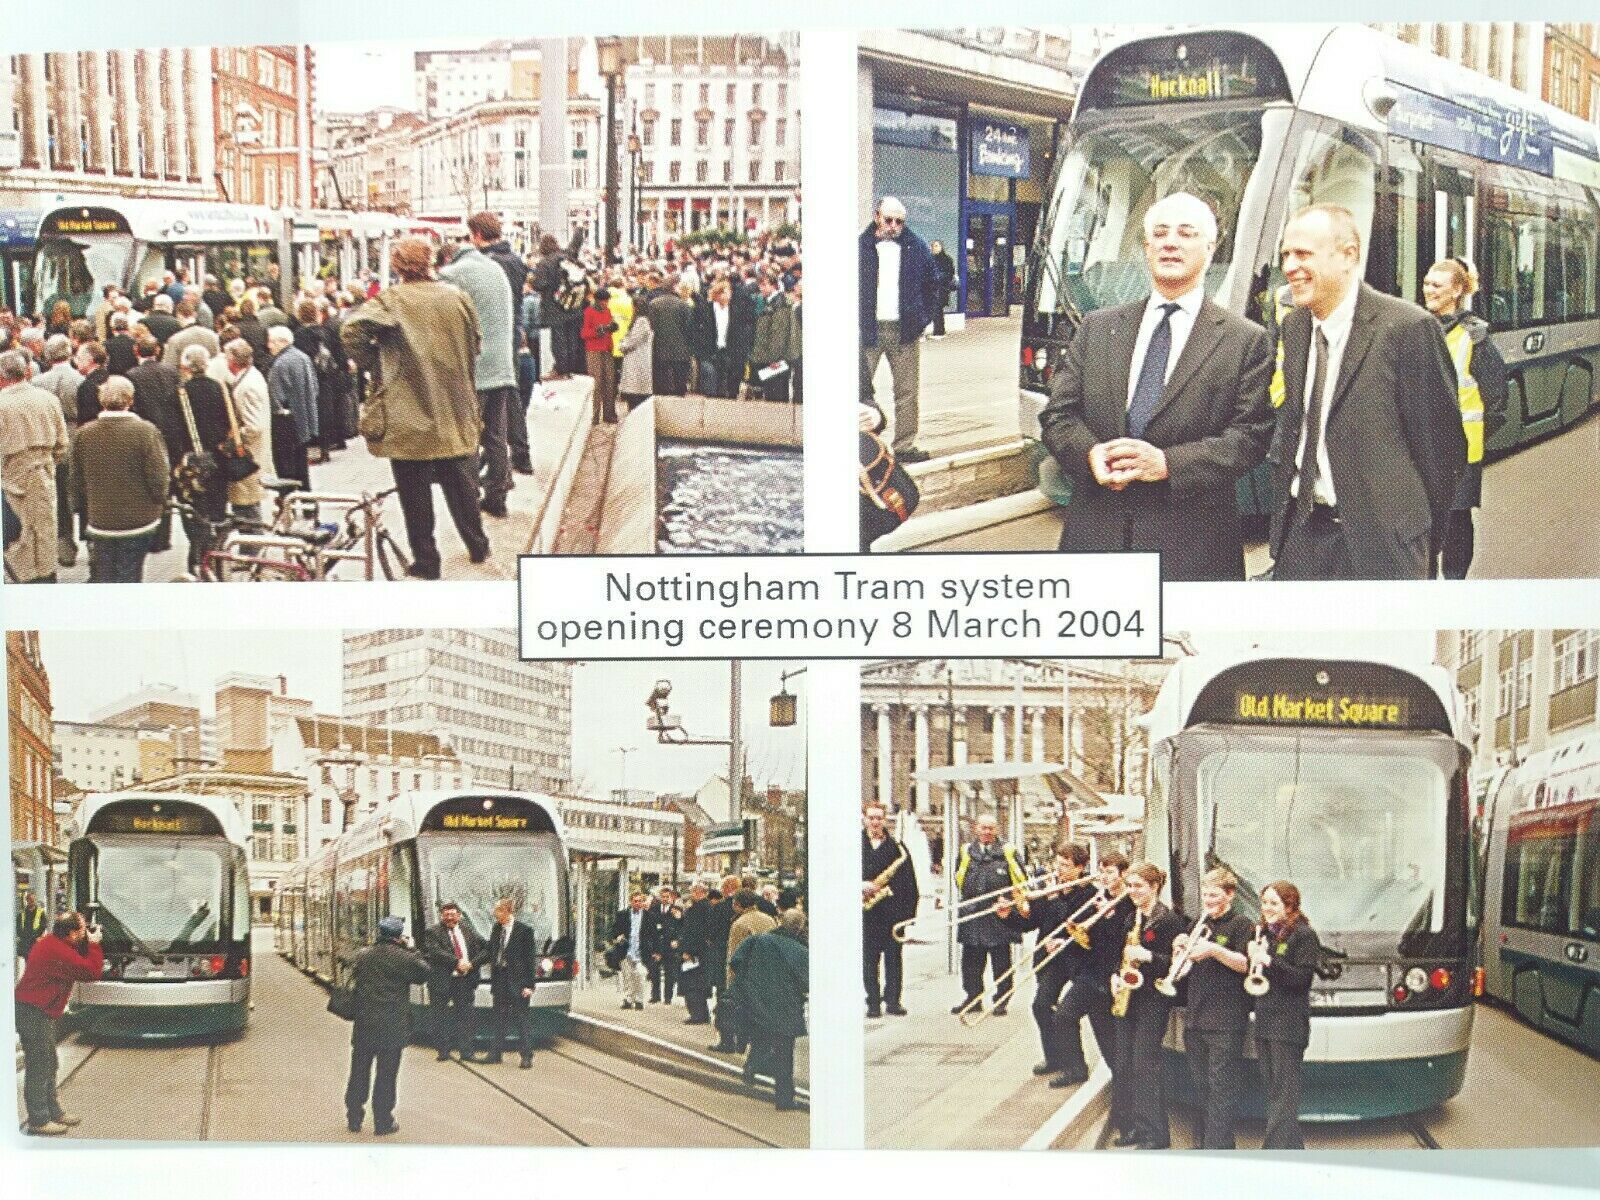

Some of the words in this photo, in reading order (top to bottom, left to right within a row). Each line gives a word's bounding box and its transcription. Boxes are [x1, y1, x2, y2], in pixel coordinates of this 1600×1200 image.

[606, 572, 819, 608] Nottingham
[834, 571, 924, 600] Tram
[941, 574, 1070, 607] system
[537, 611, 684, 648] opening
[699, 618, 879, 646] ceremony
[892, 611, 912, 638] 8
[928, 609, 1041, 638] March
[1058, 609, 1145, 638] 2004
[1240, 693, 1268, 718] Old
[1272, 694, 1334, 720] Market
[1338, 697, 1400, 723] Square
